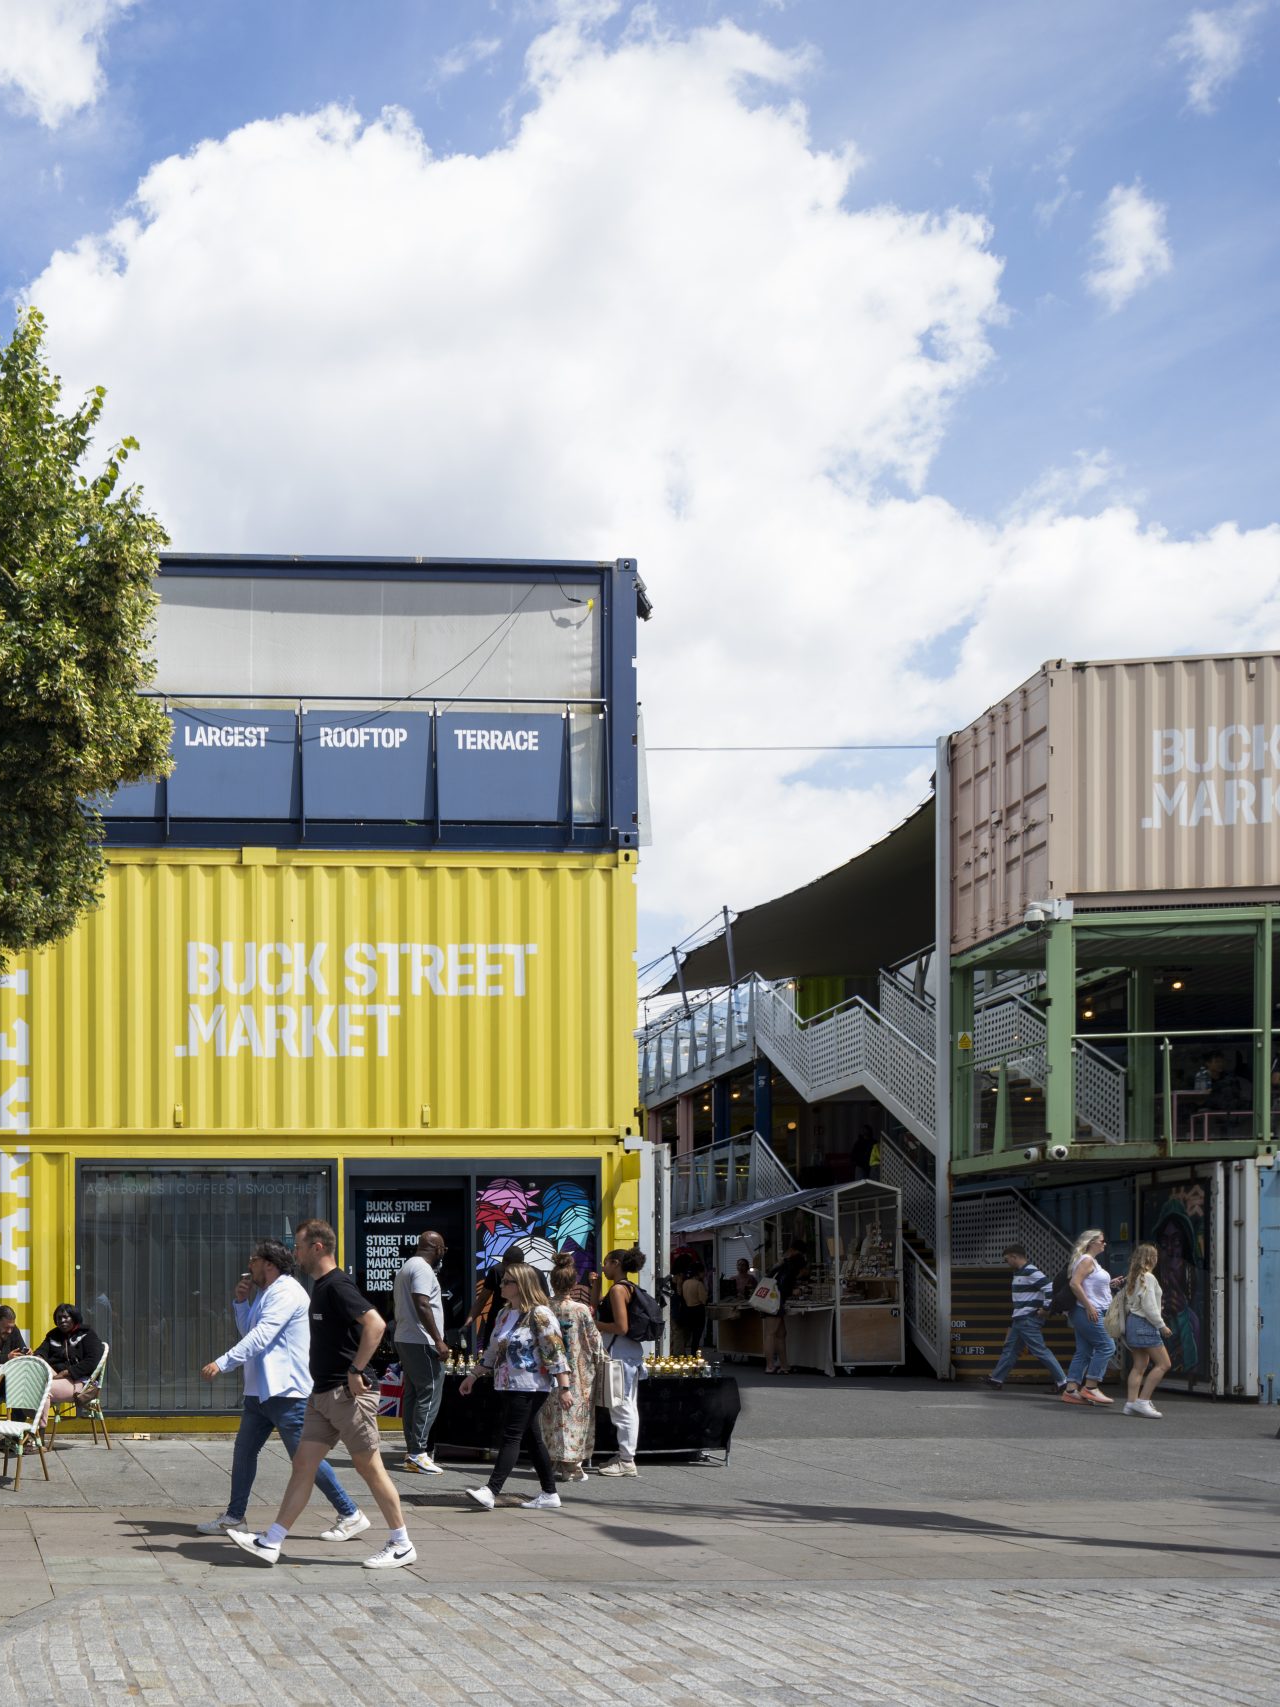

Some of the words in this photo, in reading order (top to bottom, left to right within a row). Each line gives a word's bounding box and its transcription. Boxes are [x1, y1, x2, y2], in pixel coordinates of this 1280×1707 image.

[185, 726, 269, 747] LARGEST
[320, 727, 407, 748] ROOFTOP
[453, 729, 538, 751] TERRACE
[1152, 724, 1280, 775] BUCK
[186, 941, 329, 996] BUCK
[344, 942, 538, 997] STREET
[121, 1184, 164, 1194] BOWLS
[176, 1184, 234, 1194] COFFEES
[246, 1184, 322, 1194] SMOOTHIES
[366, 1200, 393, 1212] BUCK
[395, 1200, 432, 1212] STREET
[366, 1235, 403, 1246] STREET
[366, 1246, 400, 1258] SHOPS
[366, 1269, 392, 1280] ROOF
[366, 1280, 394, 1292] BARS
[965, 1346, 985, 1354] LIFTS
